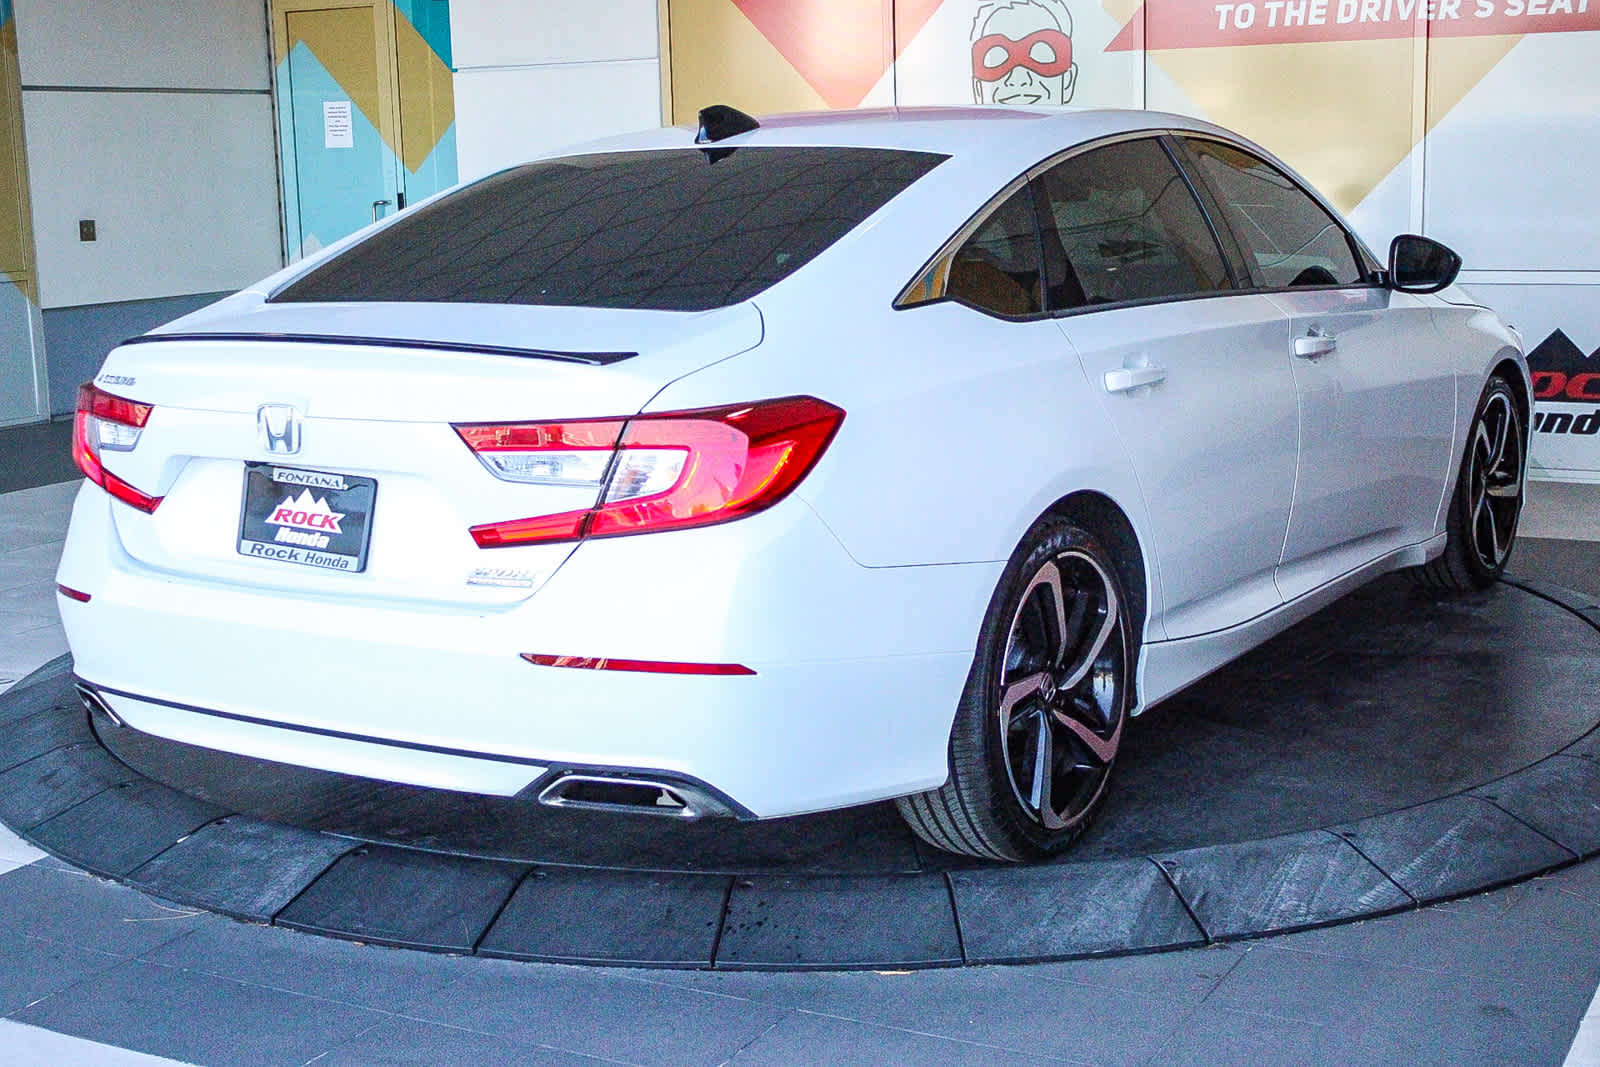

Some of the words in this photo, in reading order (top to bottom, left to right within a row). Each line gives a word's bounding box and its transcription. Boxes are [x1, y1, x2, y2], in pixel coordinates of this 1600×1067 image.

[1215, 3, 1256, 30] TO
[1264, 0, 1328, 27] THE
[1531, 371, 1600, 399] OC
[277, 471, 341, 488] FONTANA
[274, 508, 338, 530] ROCK
[250, 543, 300, 561] Rock
[304, 551, 349, 569] Honda
